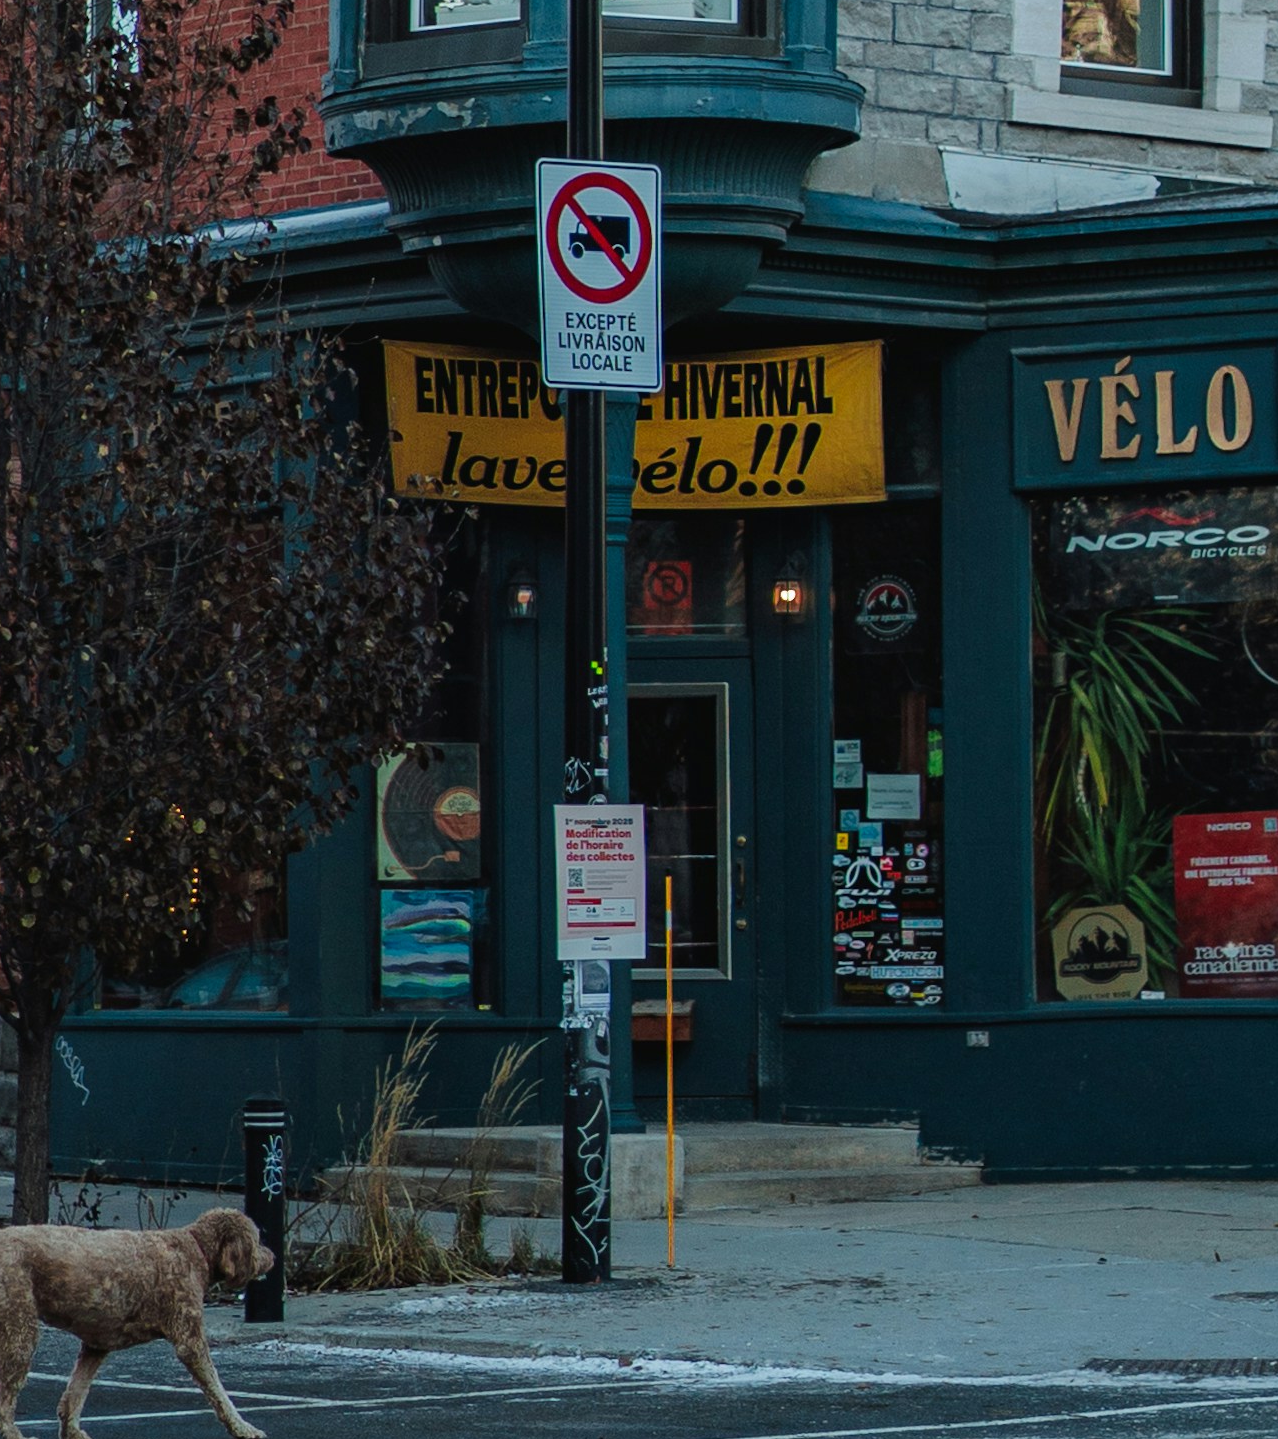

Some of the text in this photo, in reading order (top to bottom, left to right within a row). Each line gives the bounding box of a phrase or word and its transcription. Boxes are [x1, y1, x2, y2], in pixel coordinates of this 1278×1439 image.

[565, 311, 637, 332] EXCEPTÉ
[558, 331, 645, 353] LIVRAISON
[571, 352, 633, 372] LOCALE
[664, 355, 834, 421] HIVERNAL
[1043, 355, 1254, 462] VÉLO
[632, 422, 822, 497] élo!!!
[1065, 524, 1271, 554] NORCO
[1190, 544, 1267, 559] BICYCLES
[565, 829, 632, 838] Modification
[1206, 822, 1252, 832] NORCO
[566, 840, 624, 850] de l'horaire
[566, 852, 635, 862] des collectes
[834, 888, 892, 896] FUJI
[882, 948, 938, 962] XPREZO
